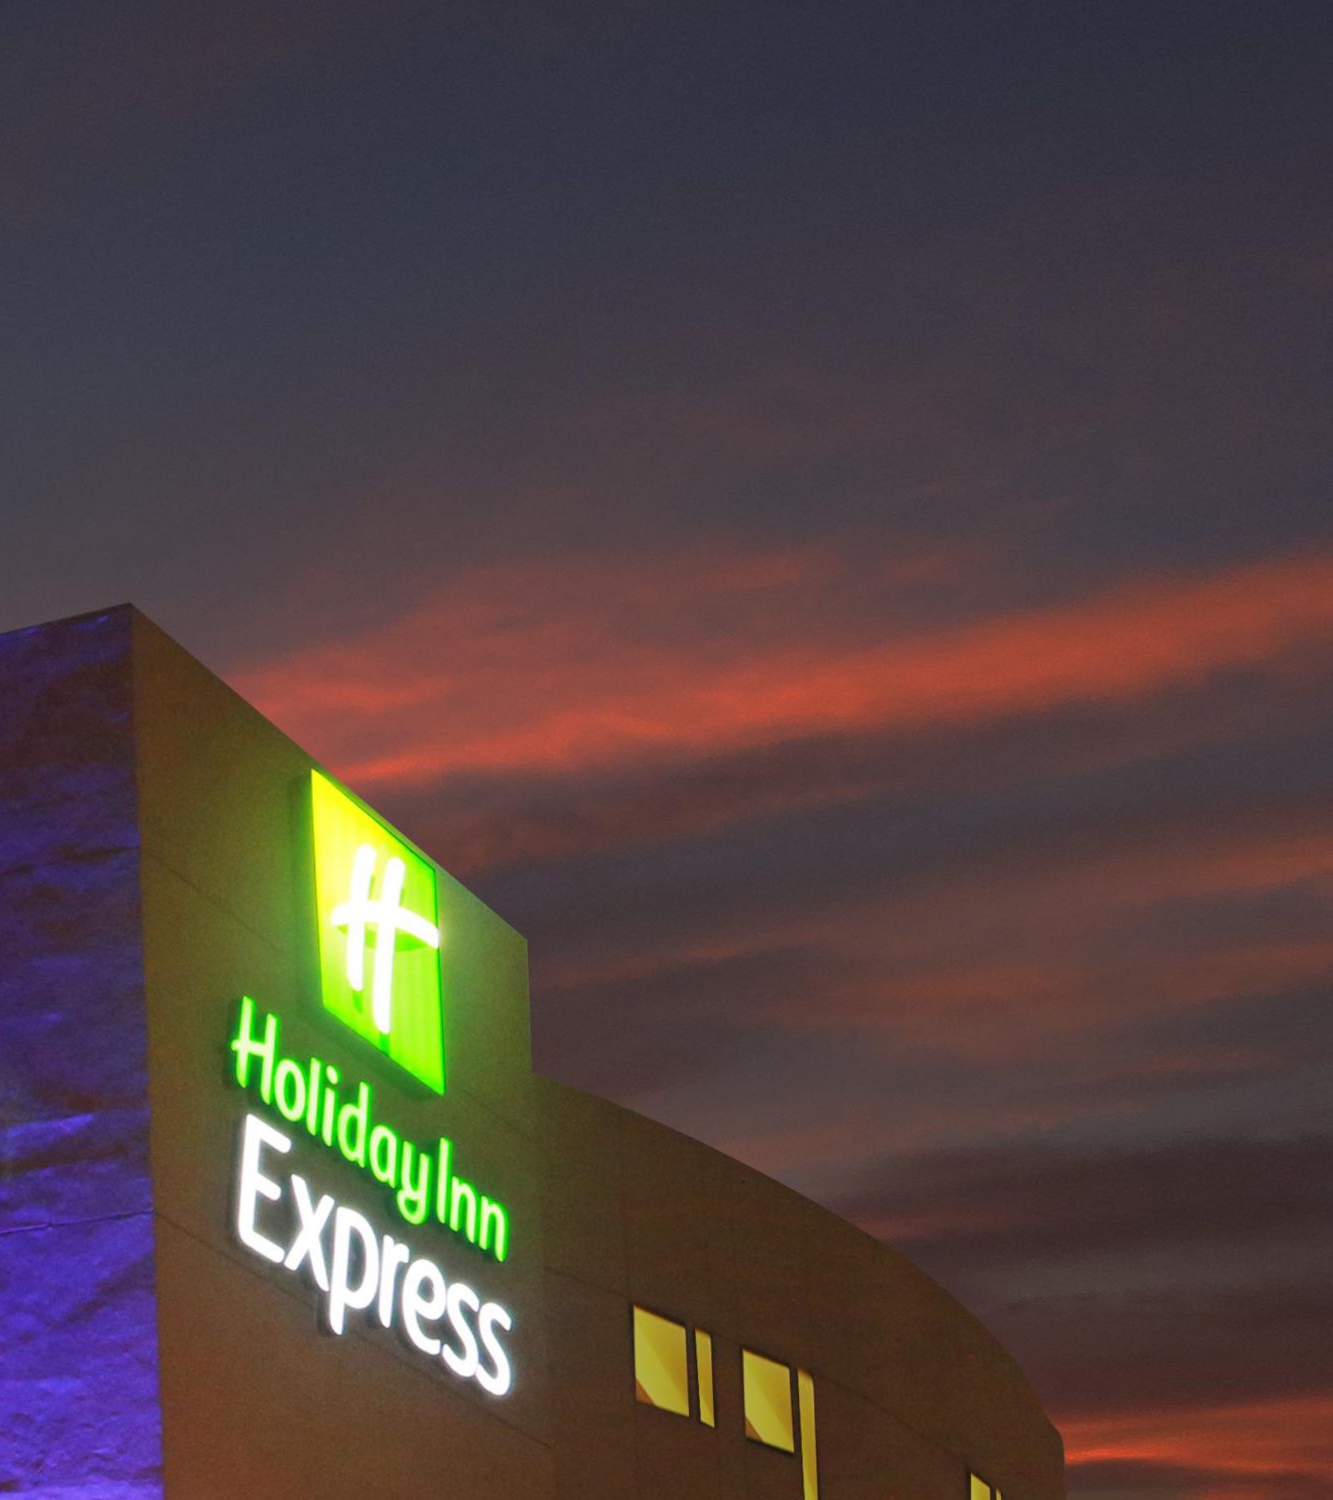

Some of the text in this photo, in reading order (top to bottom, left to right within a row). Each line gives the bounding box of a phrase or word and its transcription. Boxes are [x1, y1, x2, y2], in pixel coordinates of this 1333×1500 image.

[231, 995, 510, 1262] Holiday Inn
[237, 1112, 513, 1397] Express
